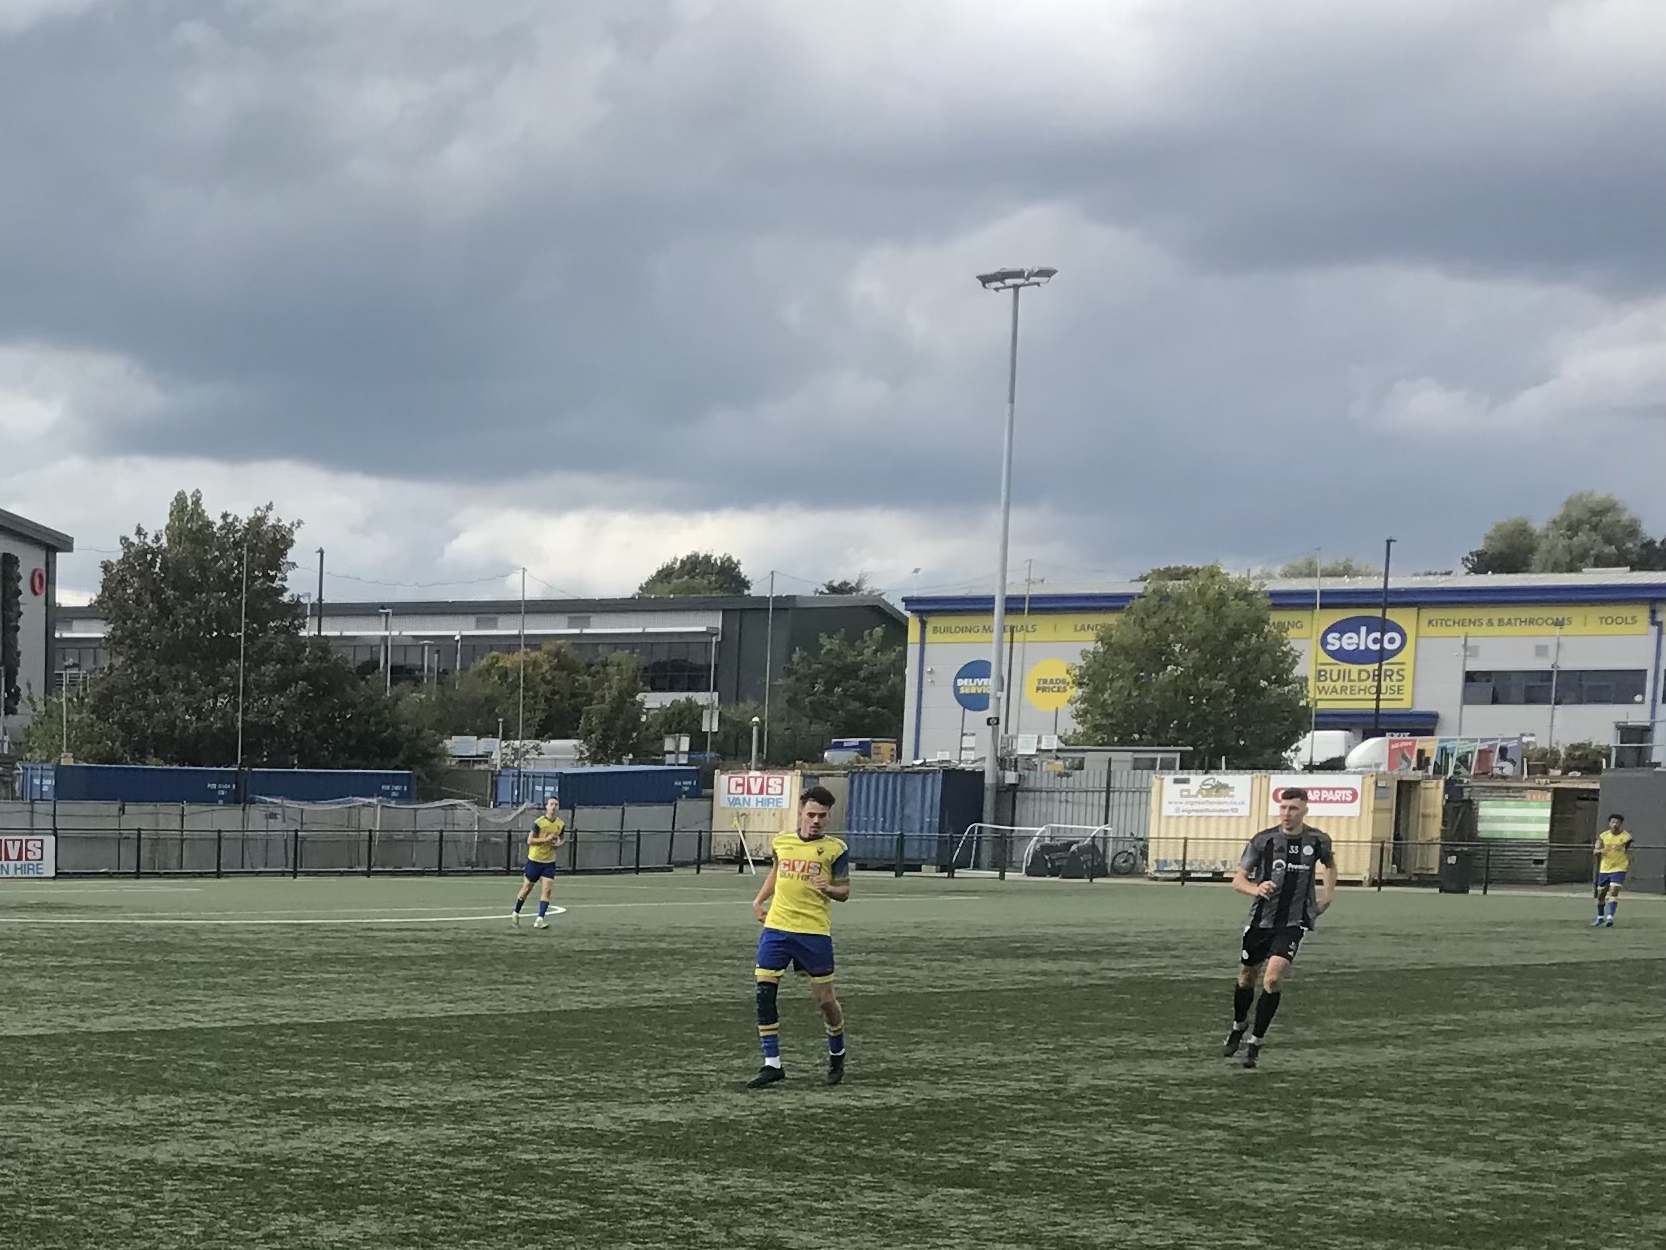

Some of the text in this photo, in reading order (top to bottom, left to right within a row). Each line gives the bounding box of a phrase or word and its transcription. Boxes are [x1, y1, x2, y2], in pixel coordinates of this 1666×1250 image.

[1427, 617, 1484, 628] KITCHENS
[1485, 617, 1495, 627] &
[1599, 615, 1638, 625] TOOLS
[932, 624, 980, 635] BUILDING
[1326, 625, 1402, 651] selco
[1317, 668, 1406, 683] BUILDERS
[956, 678, 991, 687] DELIVE
[1036, 678, 1068, 686] TRADE
[959, 686, 991, 694] SERVIC
[1035, 685, 1068, 694] PRICES
[1317, 684, 1405, 695] WAREHOUSE
[728, 776, 785, 796] CVS
[1320, 790, 1353, 802] PARTS
[727, 797, 784, 808] VAN HIRE
[1288, 845, 1300, 855] 33
[14, 863, 45, 875] HIRE
[779, 859, 822, 875] CVS
